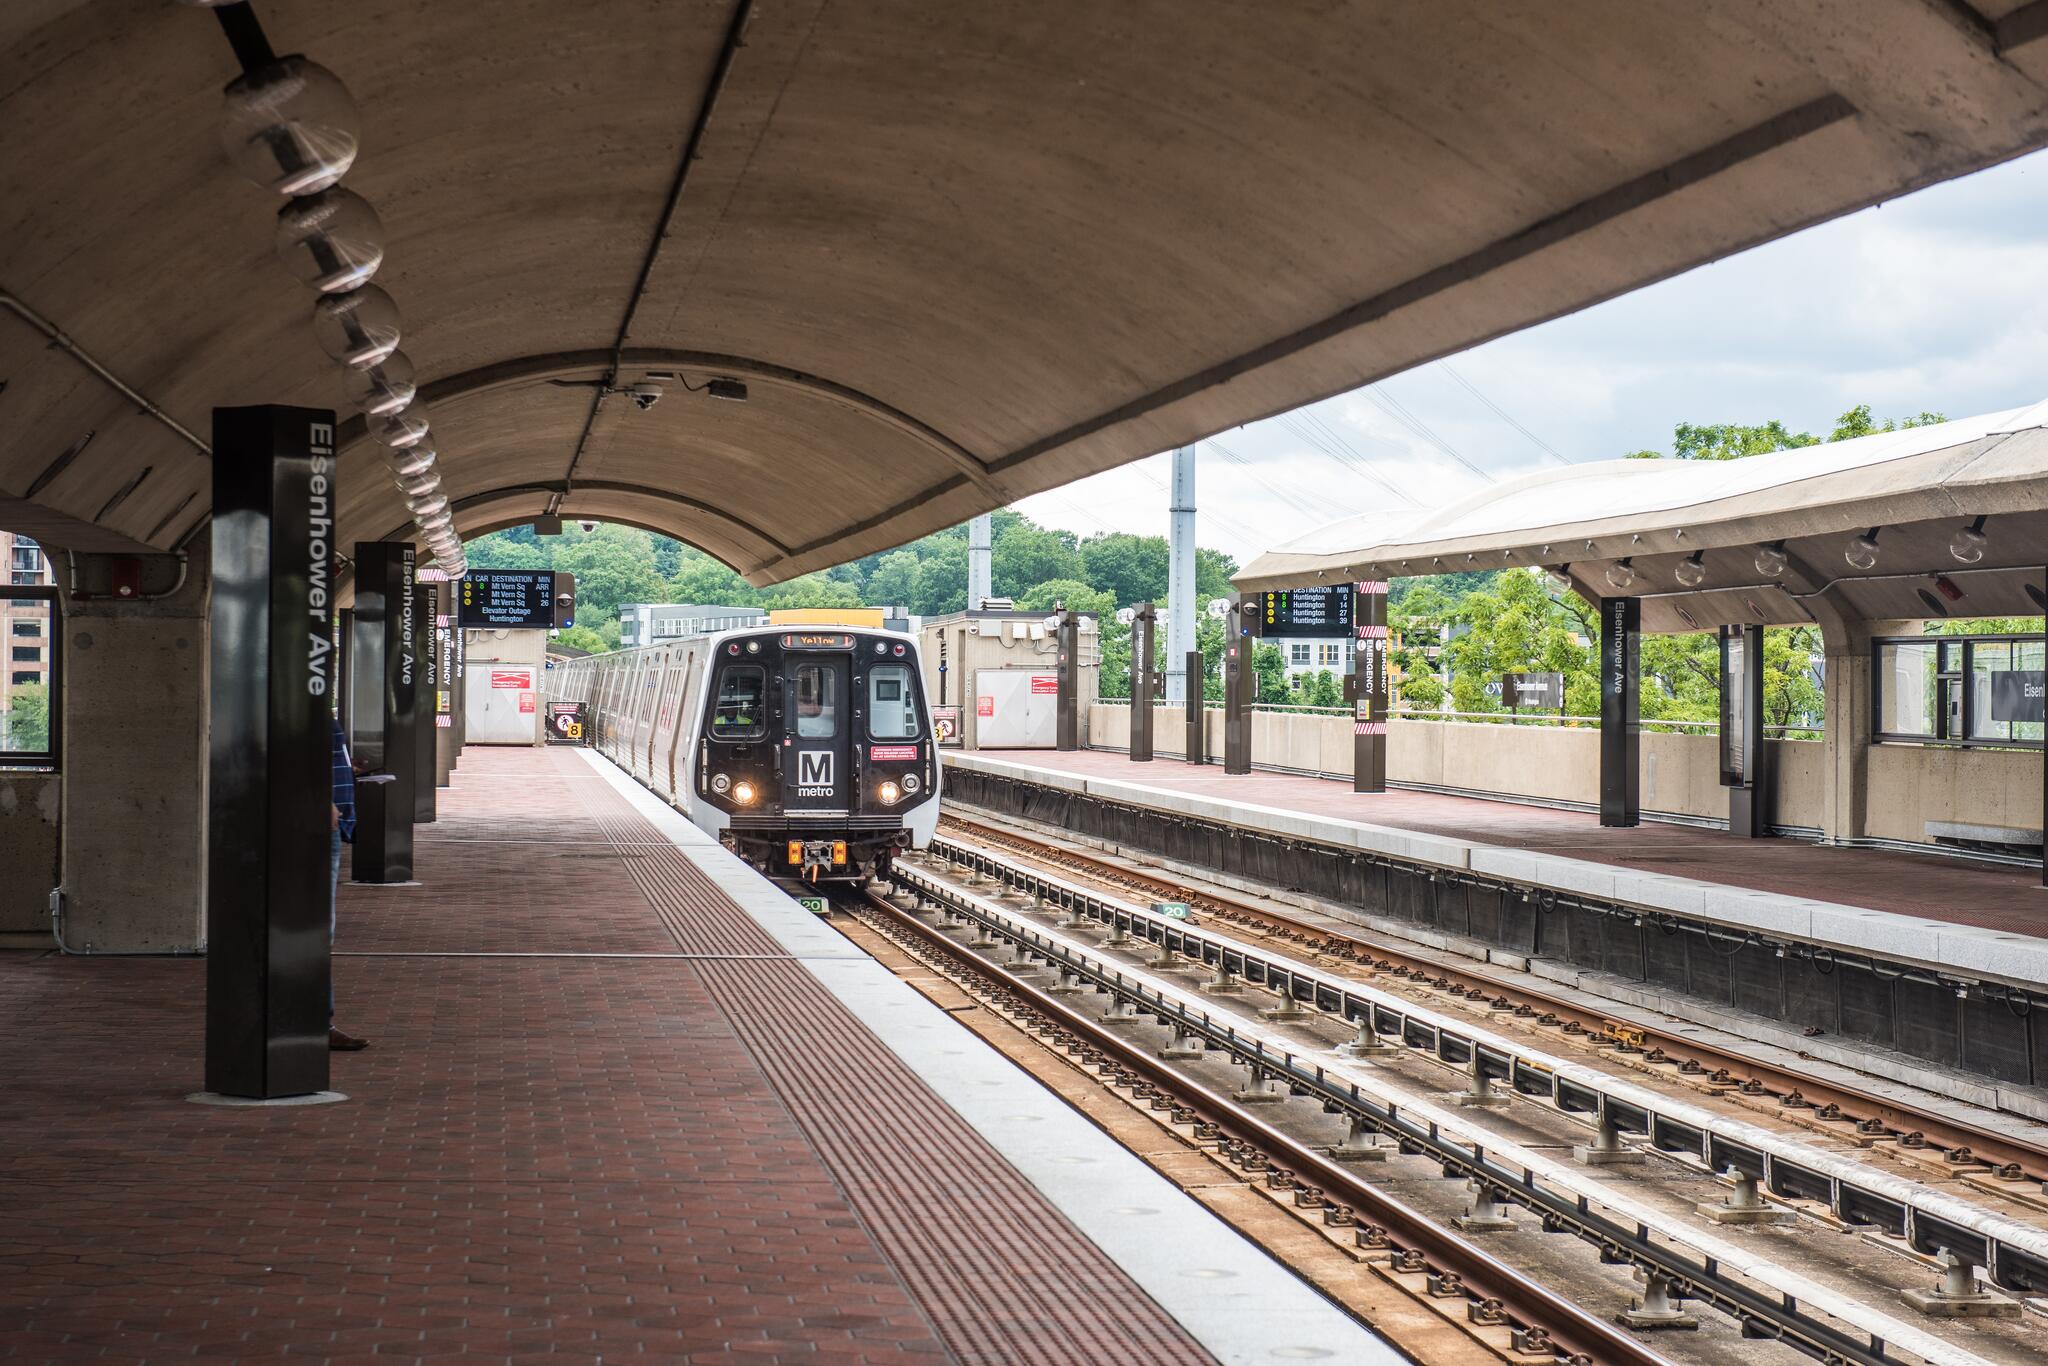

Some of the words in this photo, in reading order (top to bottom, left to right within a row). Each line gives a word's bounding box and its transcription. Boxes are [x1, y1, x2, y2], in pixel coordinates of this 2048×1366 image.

[309, 423, 333, 622] Eisenhower
[492, 575, 533, 583] DESTINATION
[516, 583, 525, 591] Sq
[403, 549, 415, 648] Eisenhower
[516, 591, 525, 599] Sq
[1293, 594, 1325, 602] Huntington
[516, 599, 525, 607] Sq
[508, 607, 531, 615] Outage
[428, 589, 437, 659] Eisenhower
[489, 615, 524, 623] Huntington
[1293, 617, 1325, 625] Huntington
[801, 636, 835, 644] Yellow
[1615, 601, 1625, 669] Eisenhower
[443, 629, 451, 685] EMERGENCY
[307, 633, 332, 695] Ave
[402, 653, 414, 685] Ave
[1366, 639, 1374, 694] EMERGENCY
[427, 662, 437, 684] Ave
[1614, 672, 1625, 694] Ave
[570, 725, 579, 735] 8
[801, 753, 831, 783] M
[798, 786, 834, 797] metro
[802, 900, 821, 911] 20
[1164, 906, 1184, 917] 20
